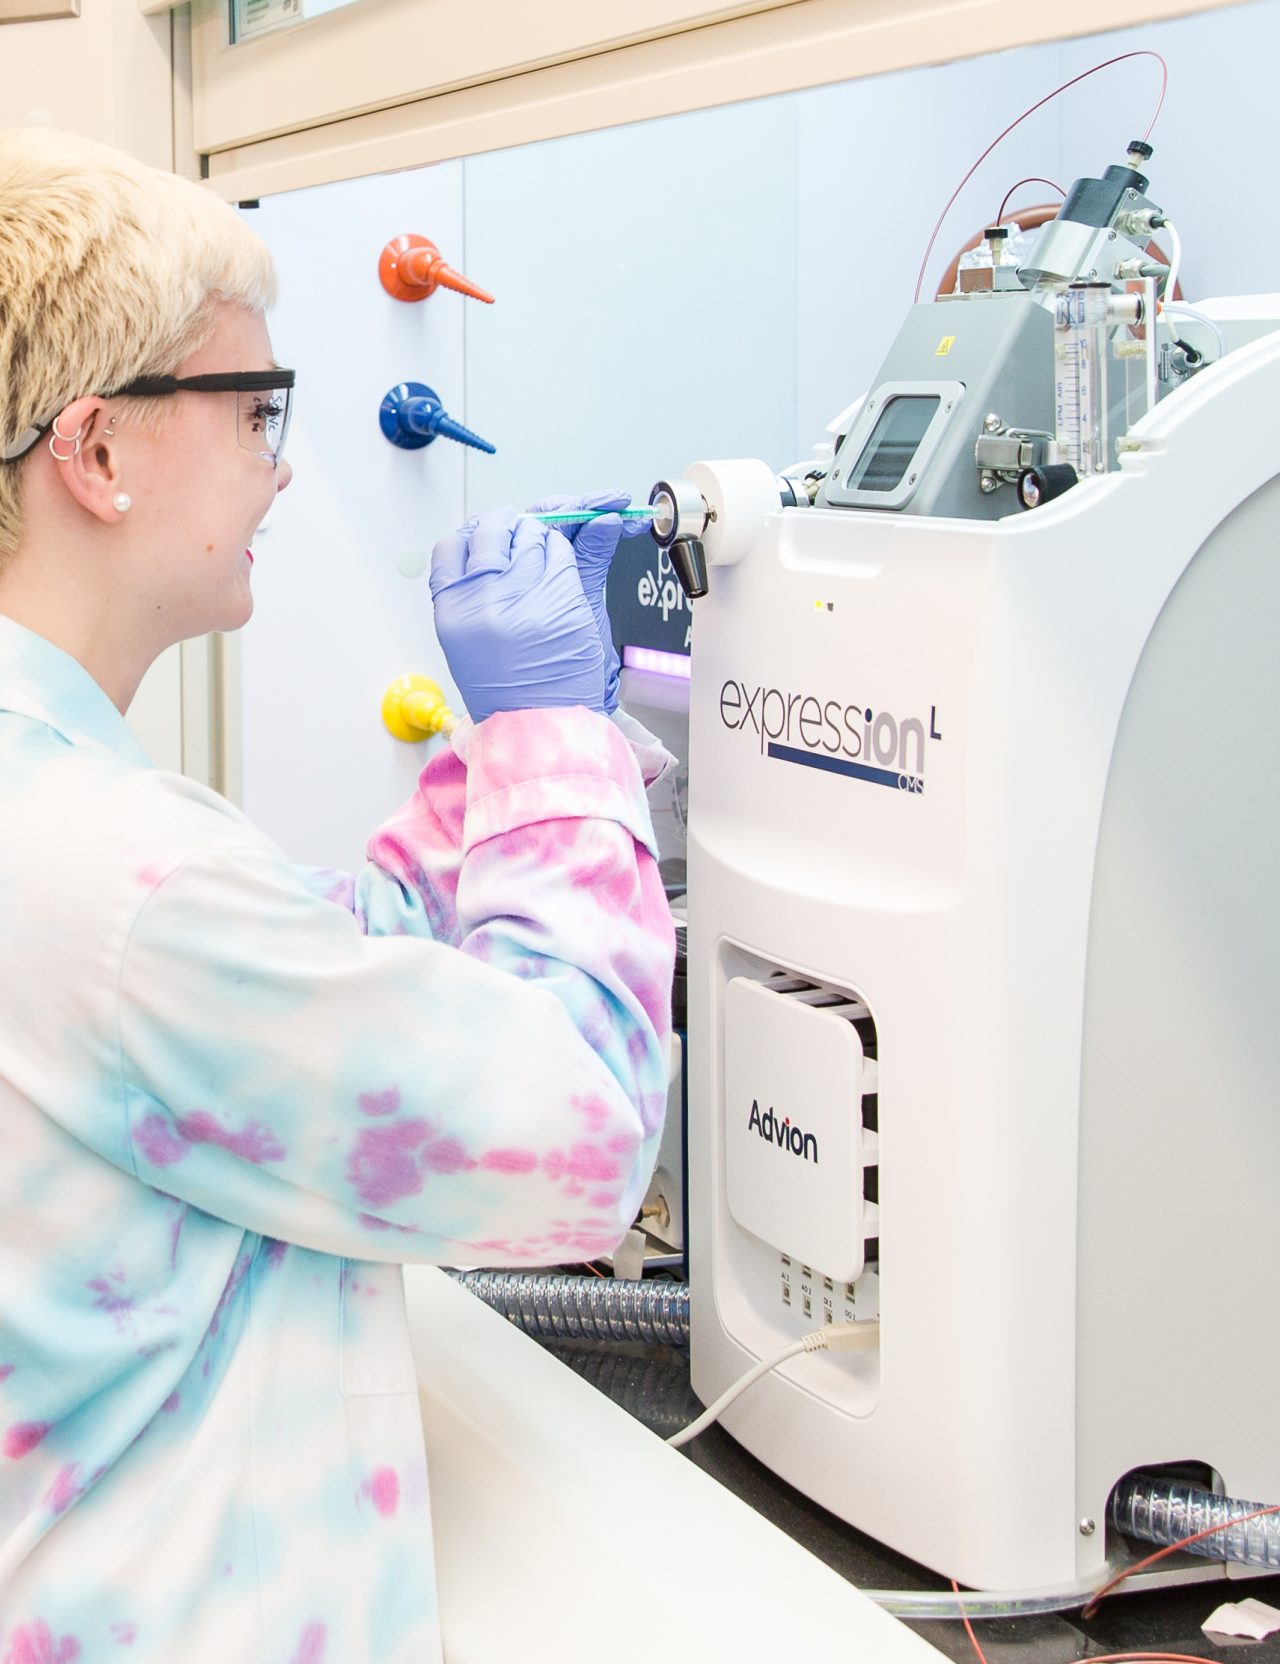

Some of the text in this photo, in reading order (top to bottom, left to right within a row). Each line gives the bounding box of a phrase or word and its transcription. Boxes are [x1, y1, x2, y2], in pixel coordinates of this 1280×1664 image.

[720, 680, 942, 773] expression L
[897, 773, 925, 796] CMS
[748, 1099, 818, 1163] Advion
